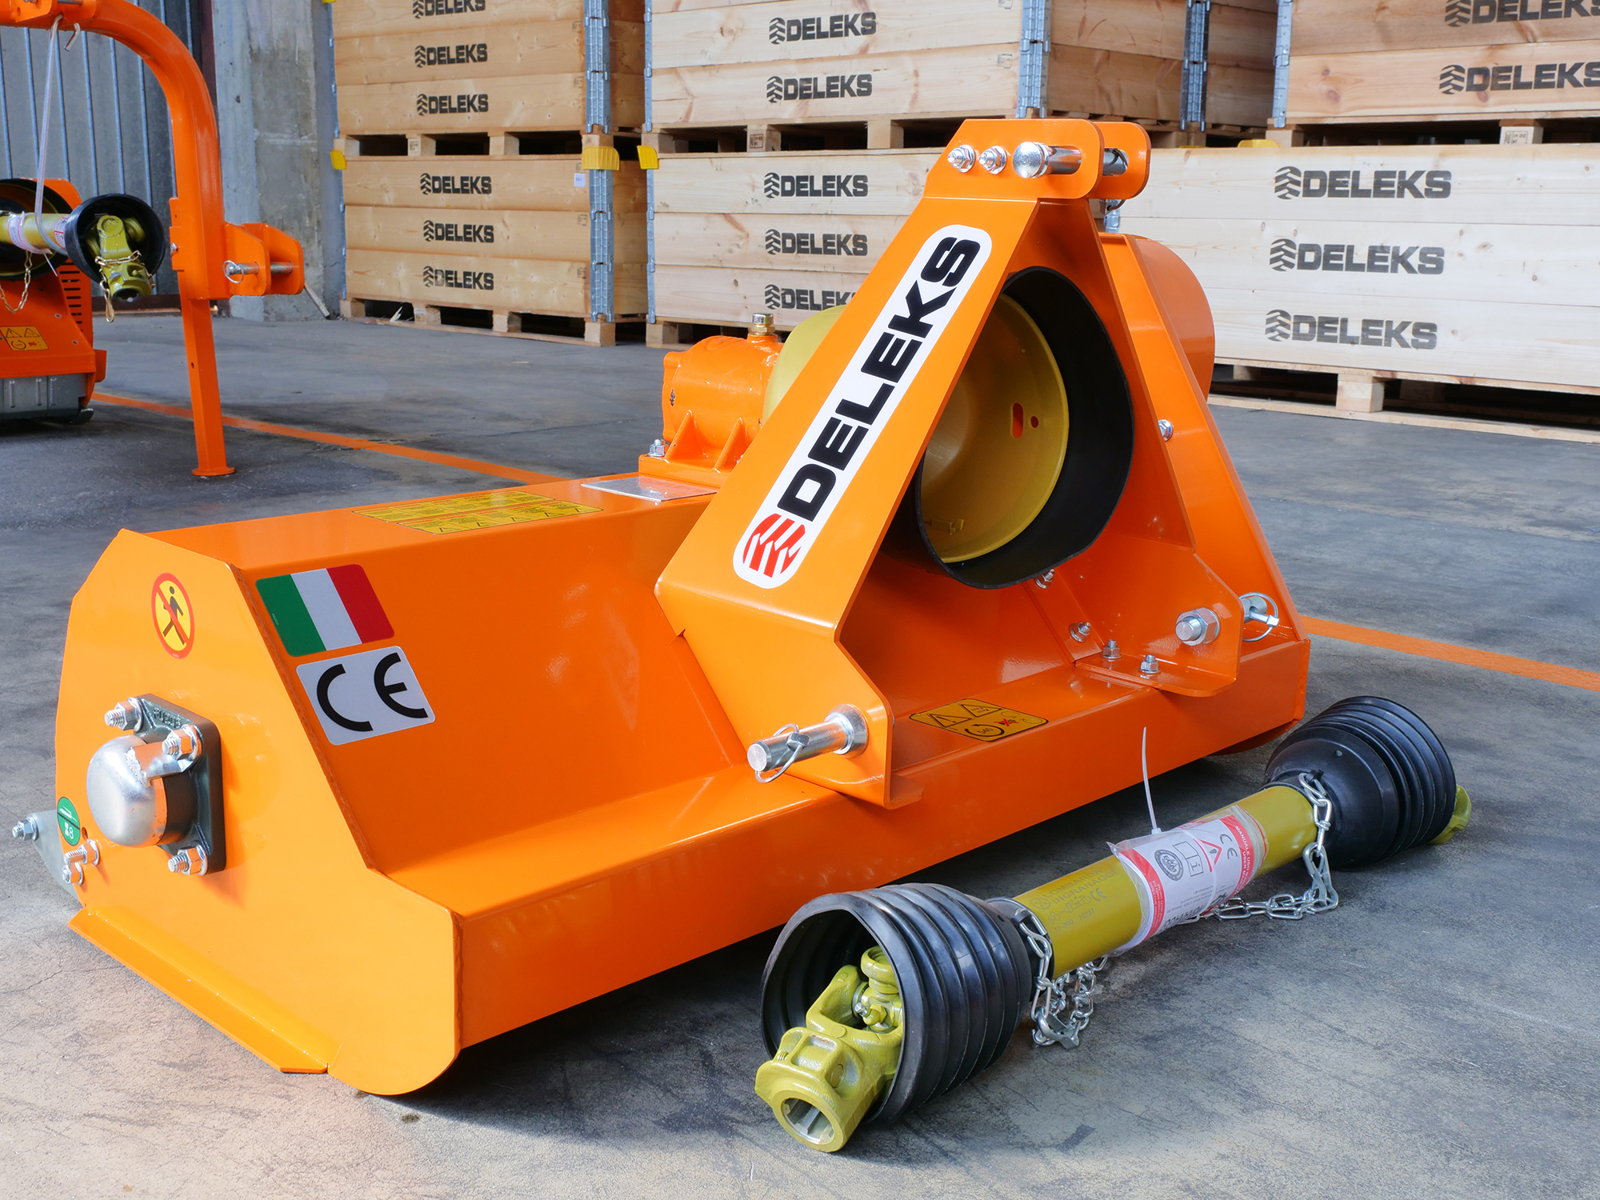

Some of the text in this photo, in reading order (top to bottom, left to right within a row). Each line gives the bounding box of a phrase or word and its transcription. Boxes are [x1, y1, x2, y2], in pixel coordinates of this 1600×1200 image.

[425, 0, 485, 16] DELEKS
[787, 12, 876, 41] DELEKS
[427, 43, 488, 66] DELEKS
[784, 74, 872, 101] DELEKS
[1466, 62, 1600, 92] DELEKS
[428, 93, 489, 115] DELEKS
[432, 175, 492, 195] DELEKS
[781, 174, 869, 197] DELEKS
[1302, 170, 1451, 198] DELEKS
[435, 222, 494, 244] DELEKS
[782, 232, 868, 256] DELEKS
[1297, 244, 1444, 275] DELEKS
[435, 269, 495, 291] DELEKS
[781, 288, 856, 311] DELEK
[1292, 315, 1437, 350] DELEKS
[778, 237, 981, 522] DELEKS
[317, 652, 428, 731] CE
[1042, 869, 1104, 898] LOMBARDA
[1090, 887, 1107, 902] CE
